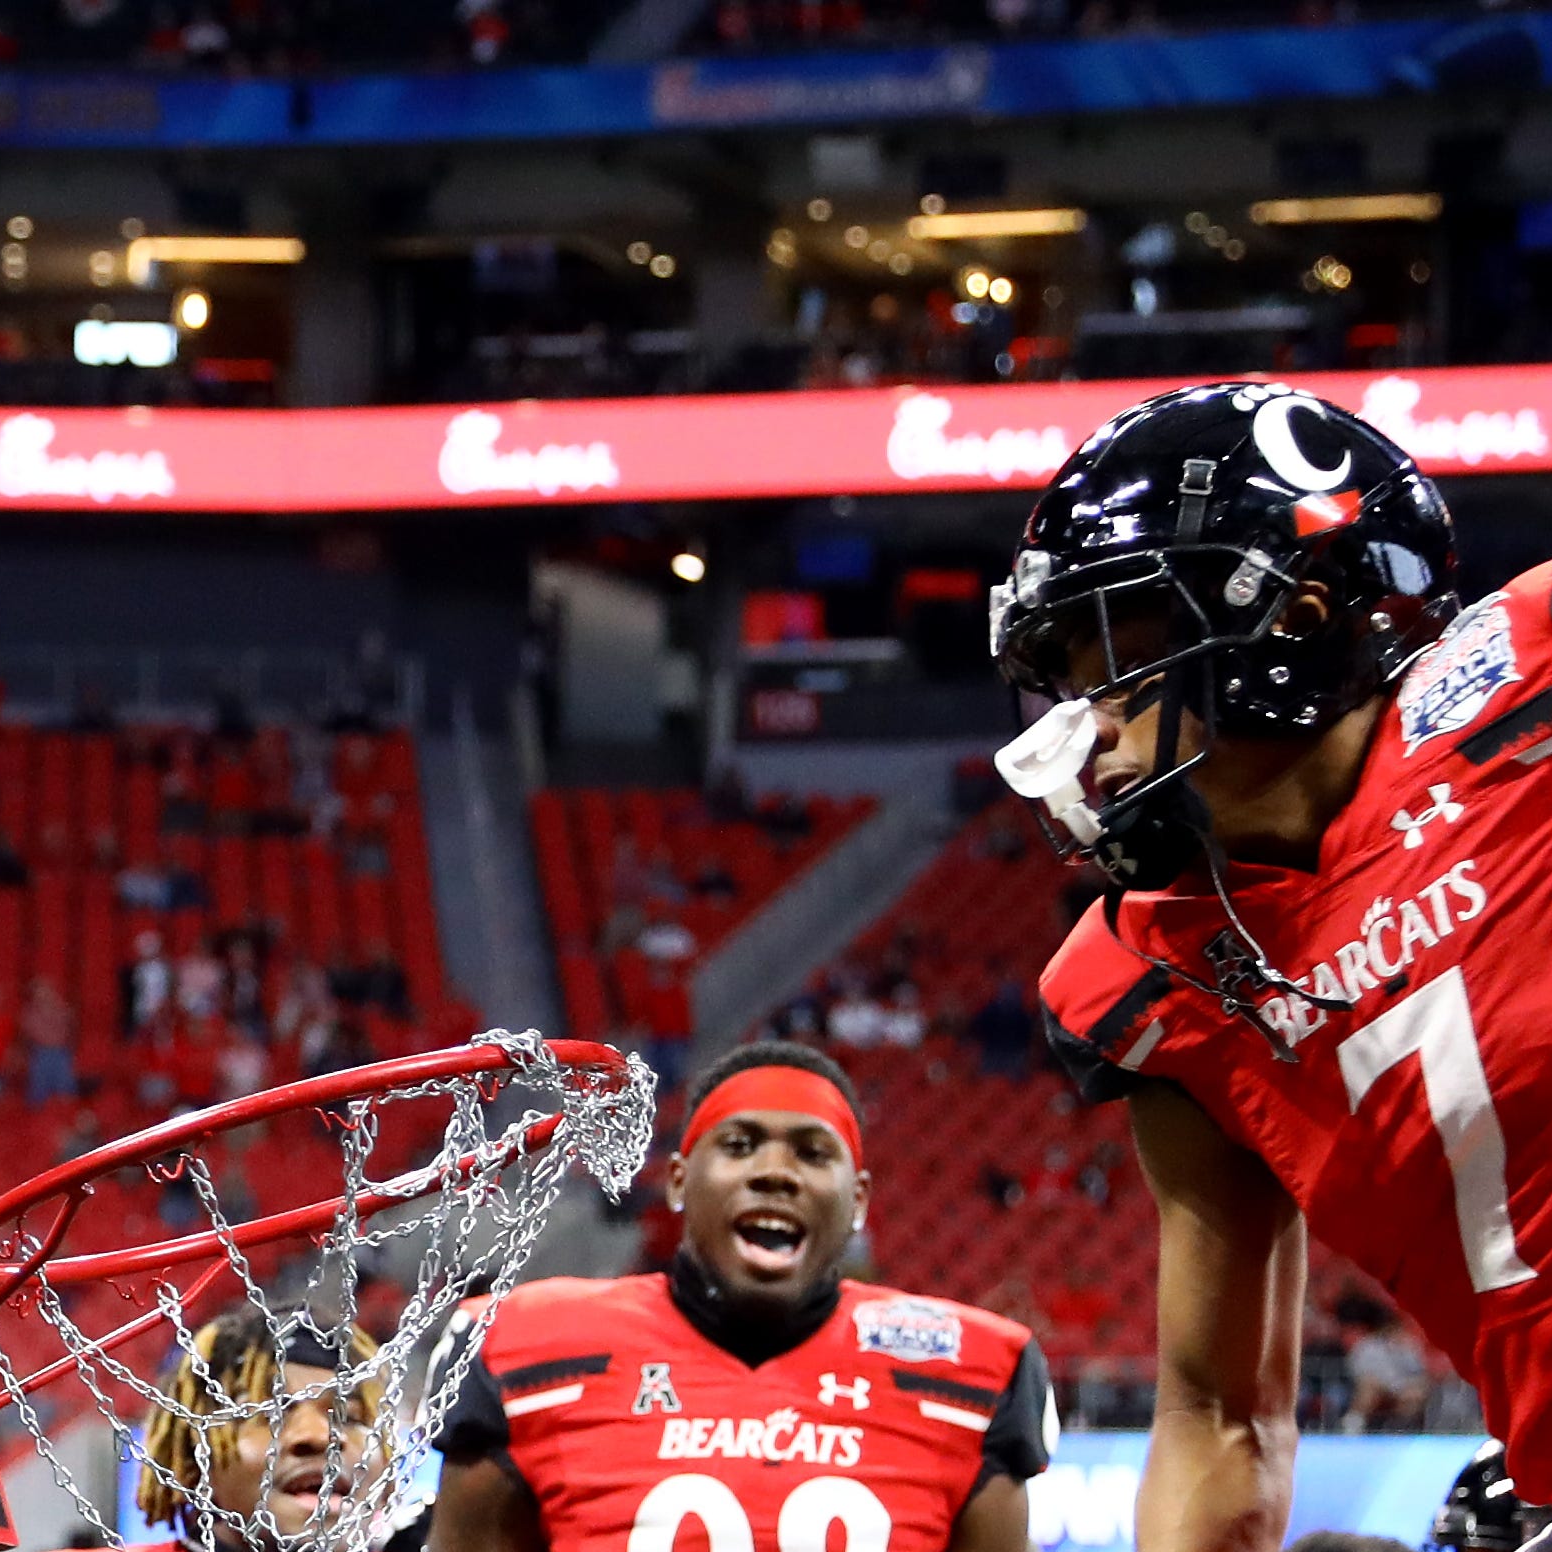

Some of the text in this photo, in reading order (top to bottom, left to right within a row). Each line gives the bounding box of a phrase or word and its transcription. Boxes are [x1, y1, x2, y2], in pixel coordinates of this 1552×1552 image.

[1255, 858, 1489, 1050] BEARCATS
[1336, 963, 1538, 1294] 7
[657, 1410, 864, 1467] BEARCATS
